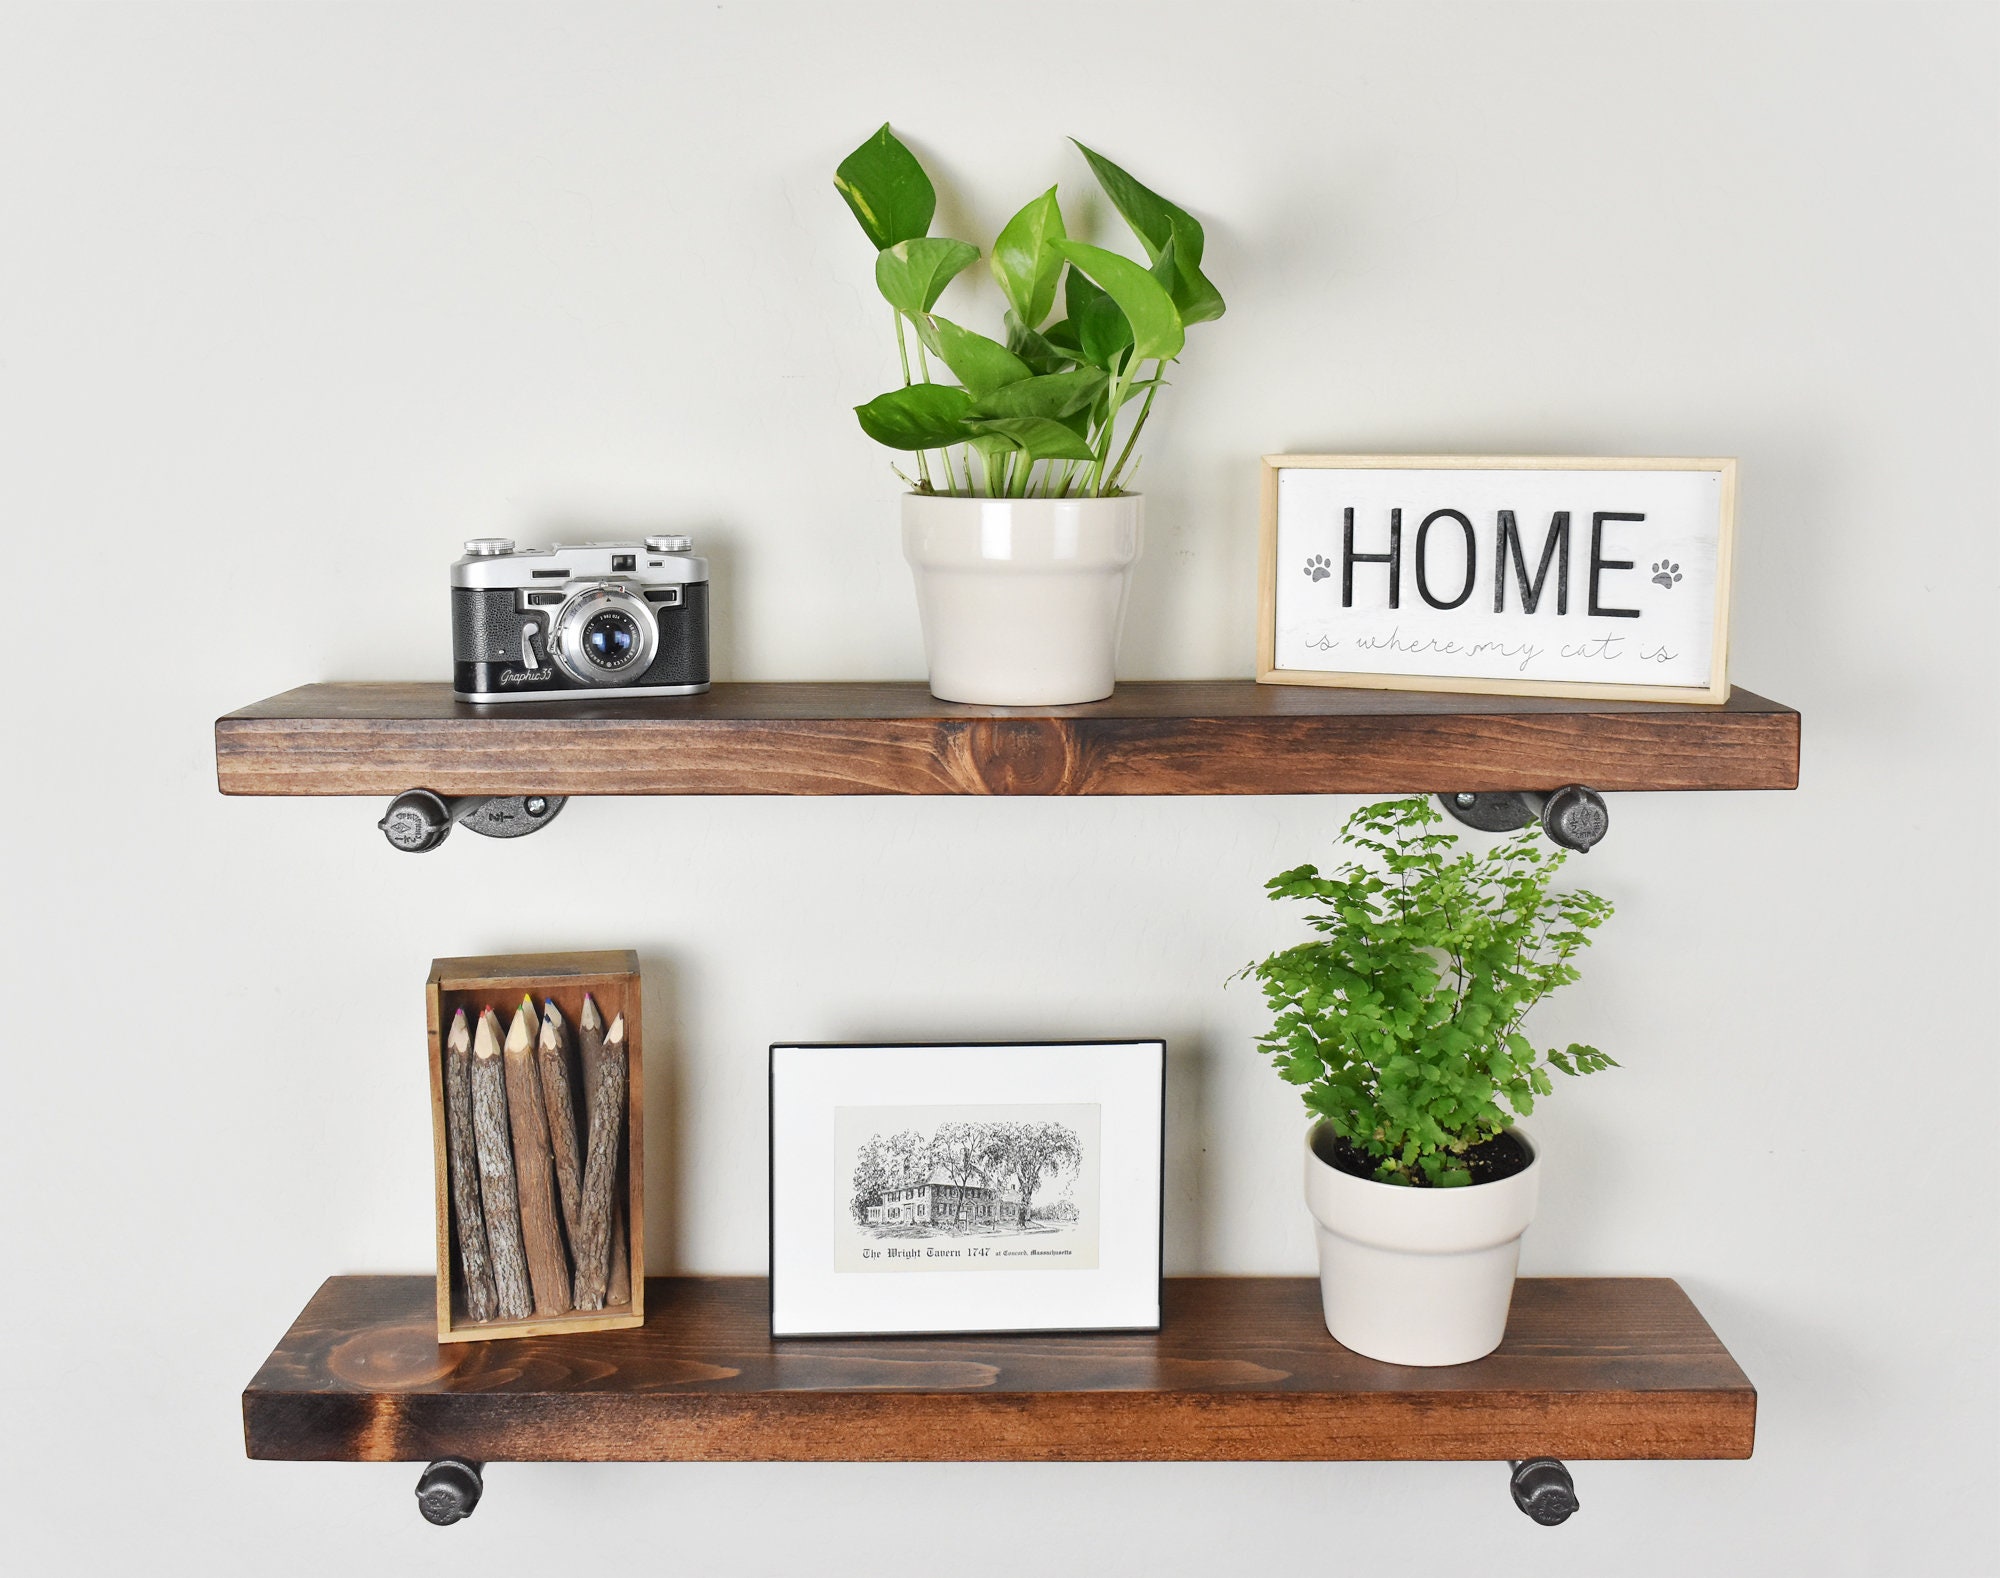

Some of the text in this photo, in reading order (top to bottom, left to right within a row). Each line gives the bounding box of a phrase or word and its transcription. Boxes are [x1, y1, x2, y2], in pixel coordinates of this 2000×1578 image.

[1341, 507, 1646, 618] HOME
[1305, 626, 1681, 673] is where my cat is
[862, 1248, 882, 1260] The
[887, 1248, 921, 1260] Wright
[926, 1247, 961, 1258] Tavern
[967, 1247, 991, 1257] 1747
